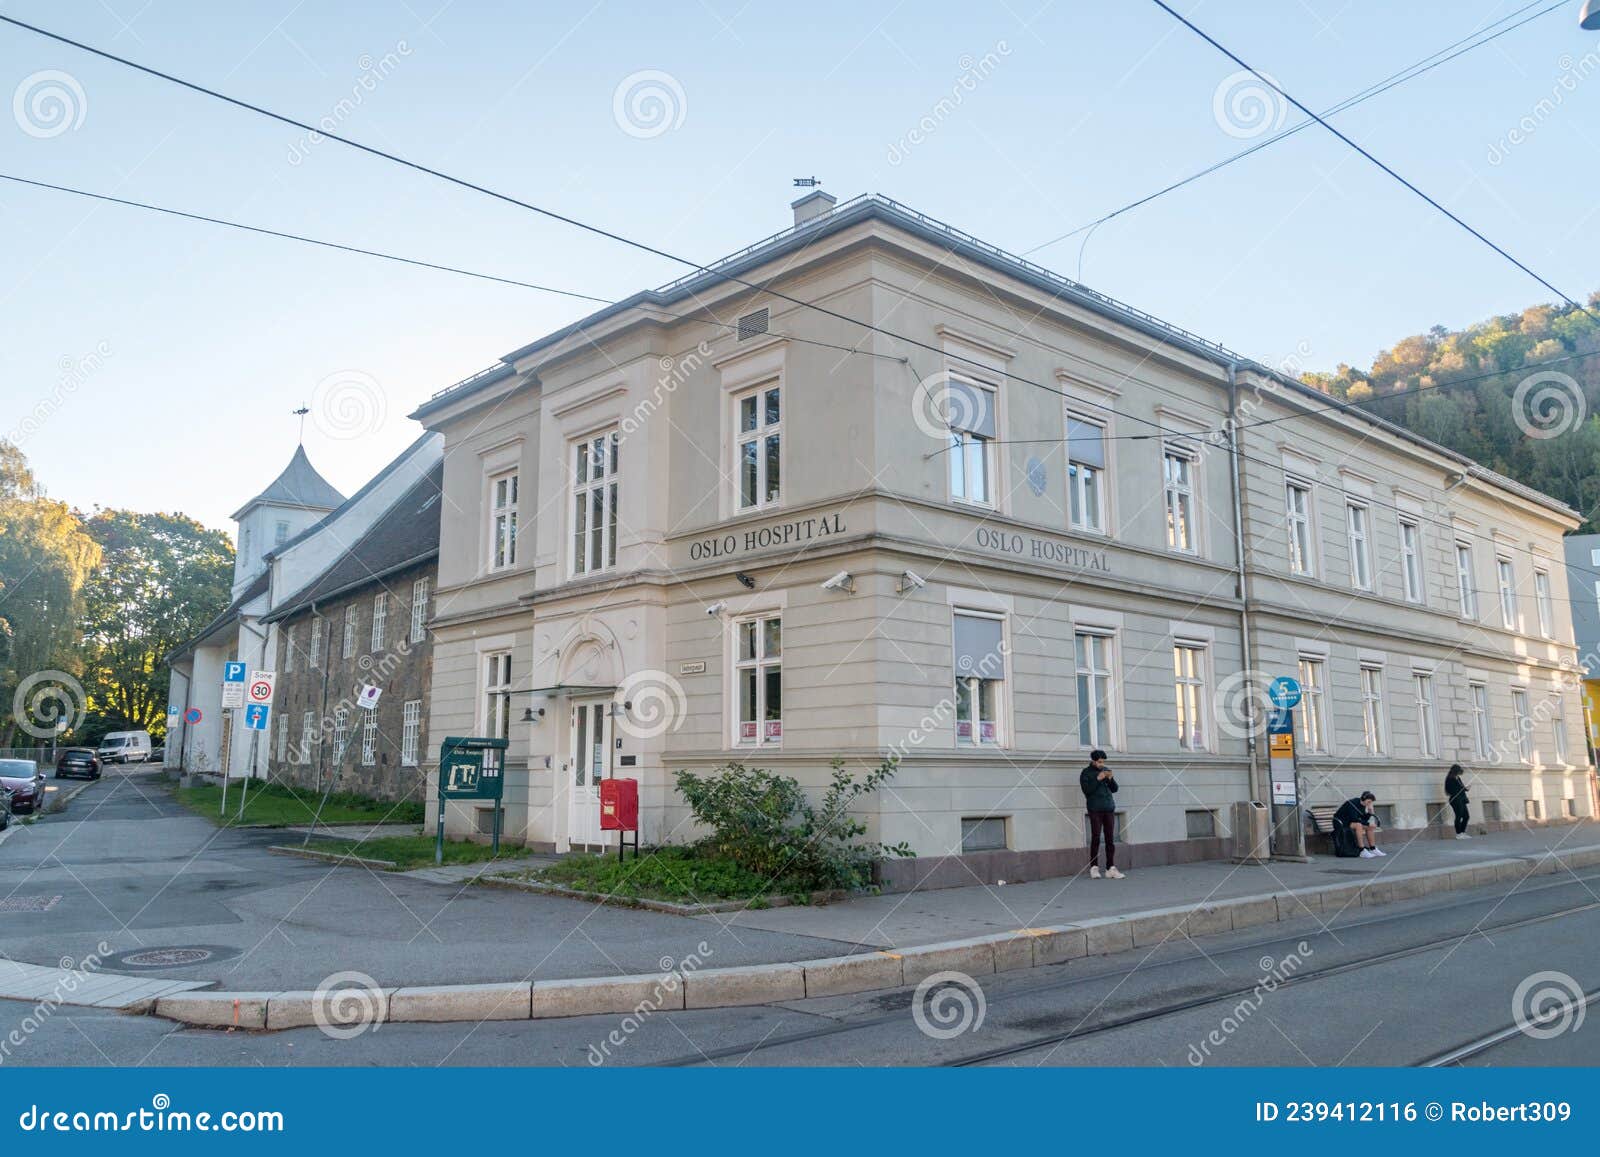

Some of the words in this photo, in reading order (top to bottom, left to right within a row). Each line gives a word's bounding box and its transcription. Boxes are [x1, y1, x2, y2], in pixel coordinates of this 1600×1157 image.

[690, 535, 736, 561] OSLO
[744, 513, 847, 551] HOSPITAL
[976, 527, 1024, 554] OSLO
[1031, 538, 1111, 572] HOSPITAL
[228, 664, 241, 680] P
[254, 671, 273, 680] Sone
[254, 686, 268, 696] 30
